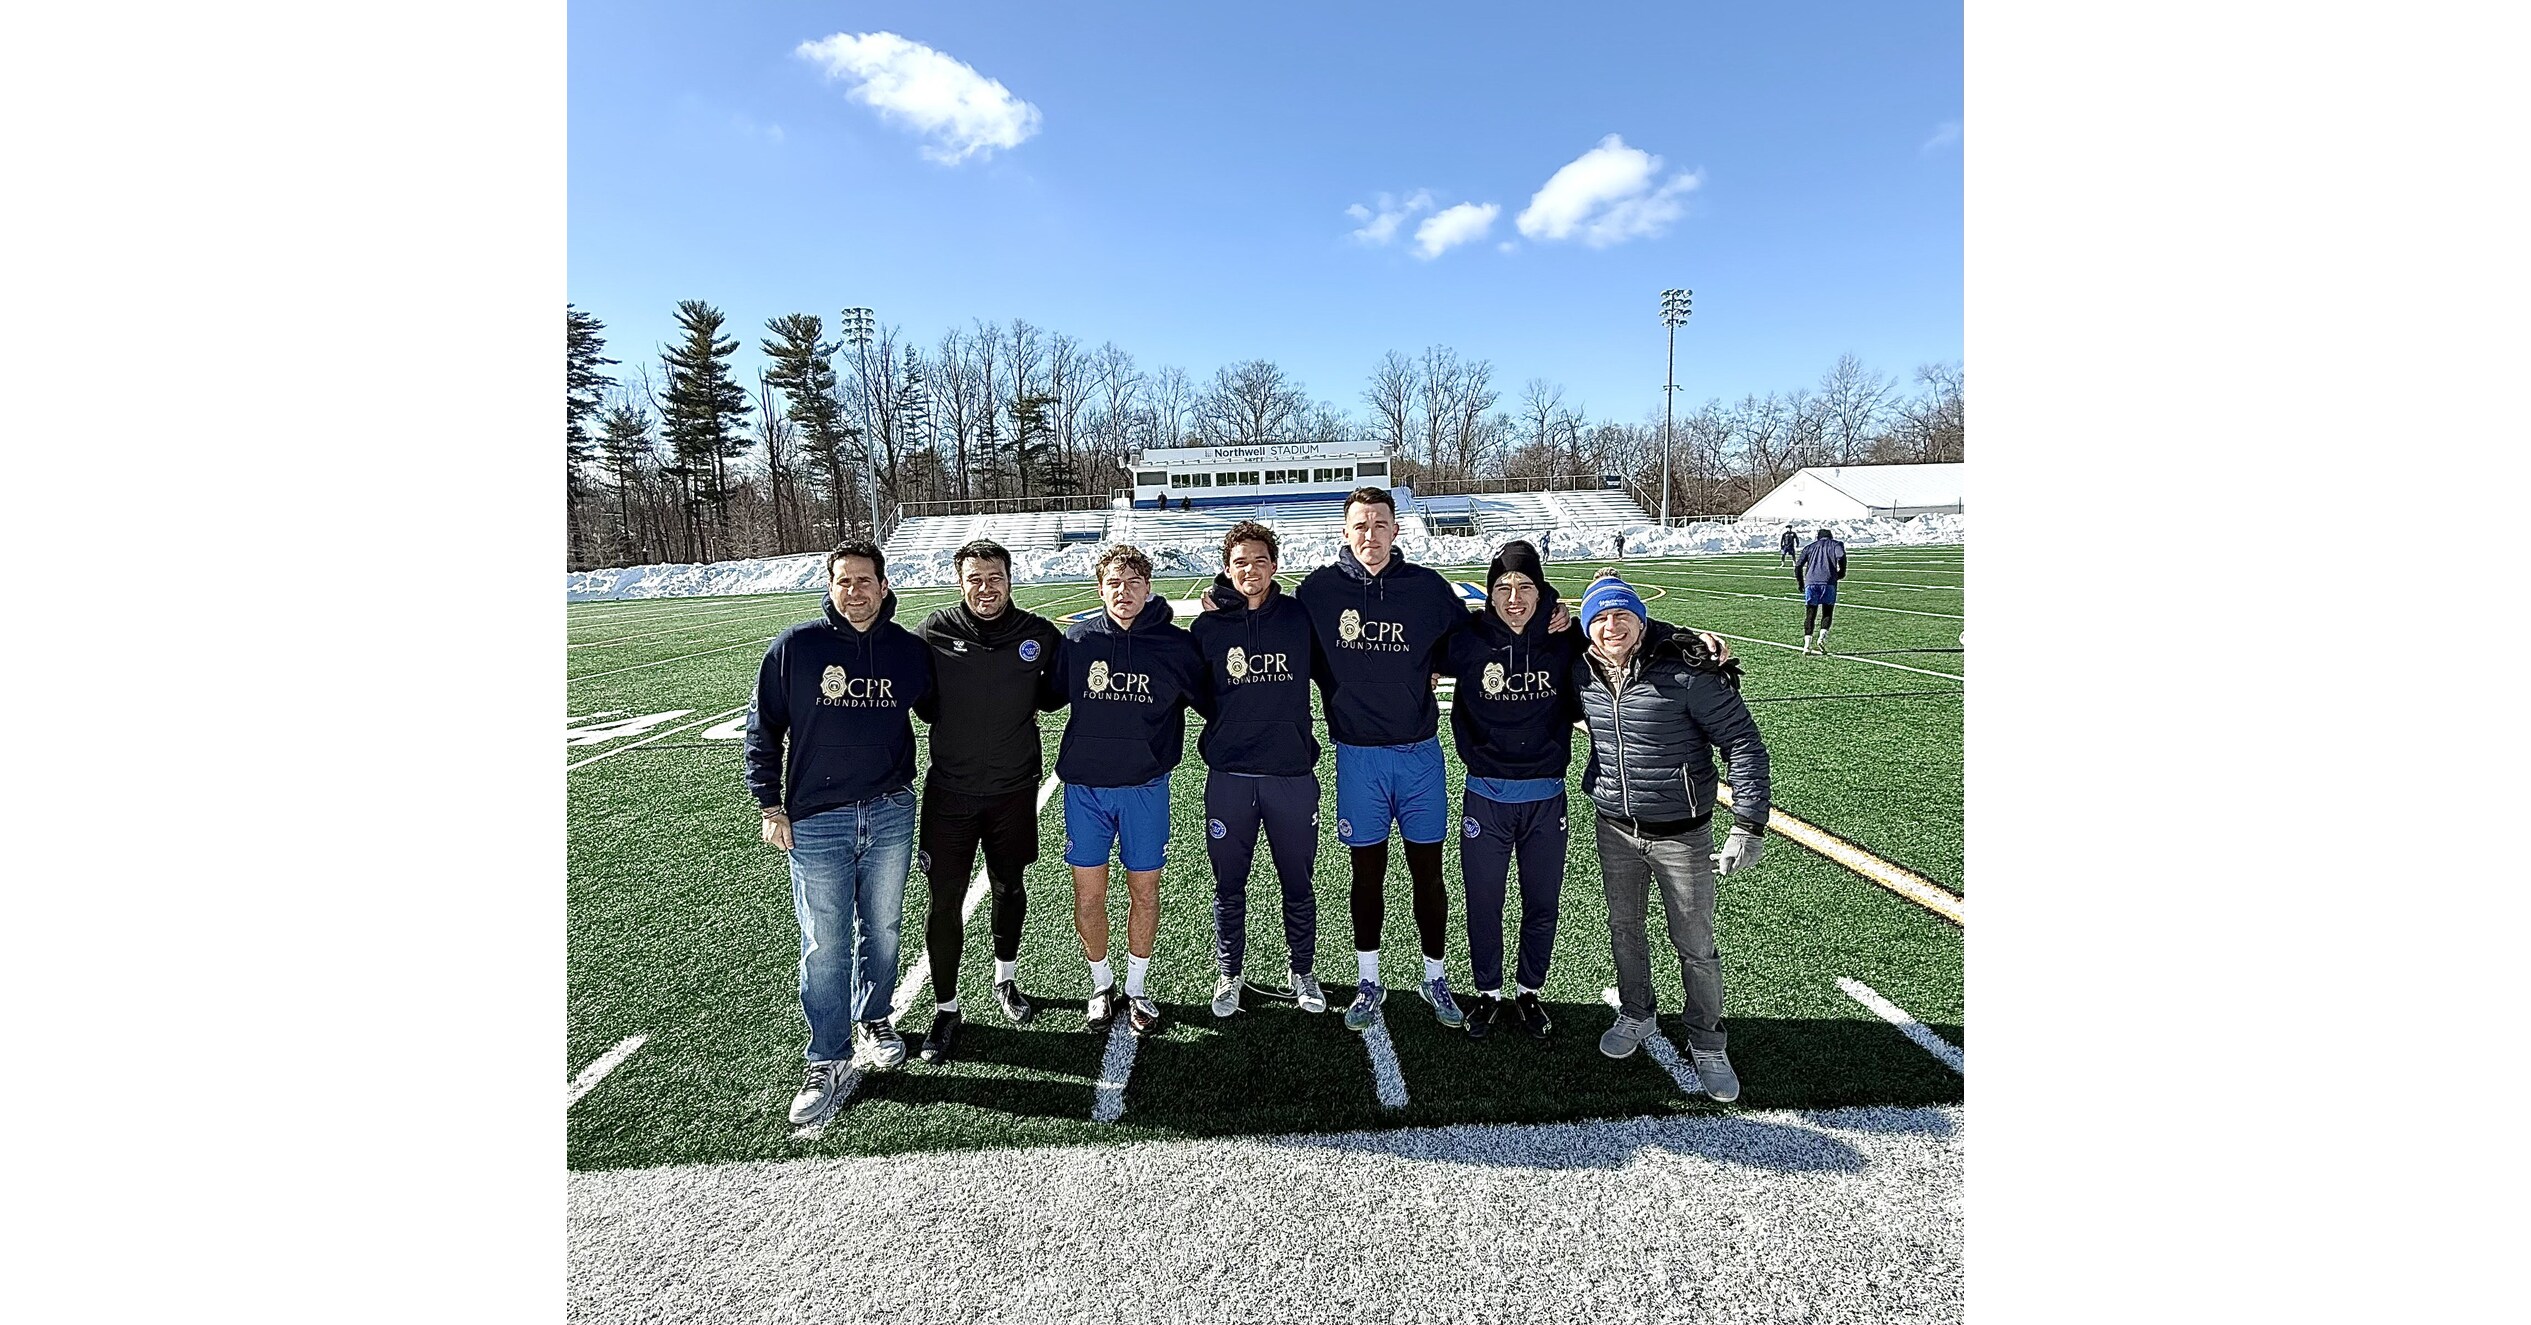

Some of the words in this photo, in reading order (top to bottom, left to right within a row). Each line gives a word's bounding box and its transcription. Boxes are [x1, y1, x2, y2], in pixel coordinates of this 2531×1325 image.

[1214, 447, 1266, 457] Northwell
[1270, 445, 1319, 455] STADIUM
[1361, 621, 1405, 643] CPR
[1335, 639, 1410, 652] FOUNDATION
[1249, 653, 1289, 674] CPR
[847, 678, 893, 698] CPR
[1110, 672, 1150, 694] CPR
[1505, 671, 1552, 692] CPR
[815, 697, 898, 708] FOUNDATION
[1083, 690, 1154, 704] FOUNDATION
[1478, 687, 1557, 701] FOUNDATION
